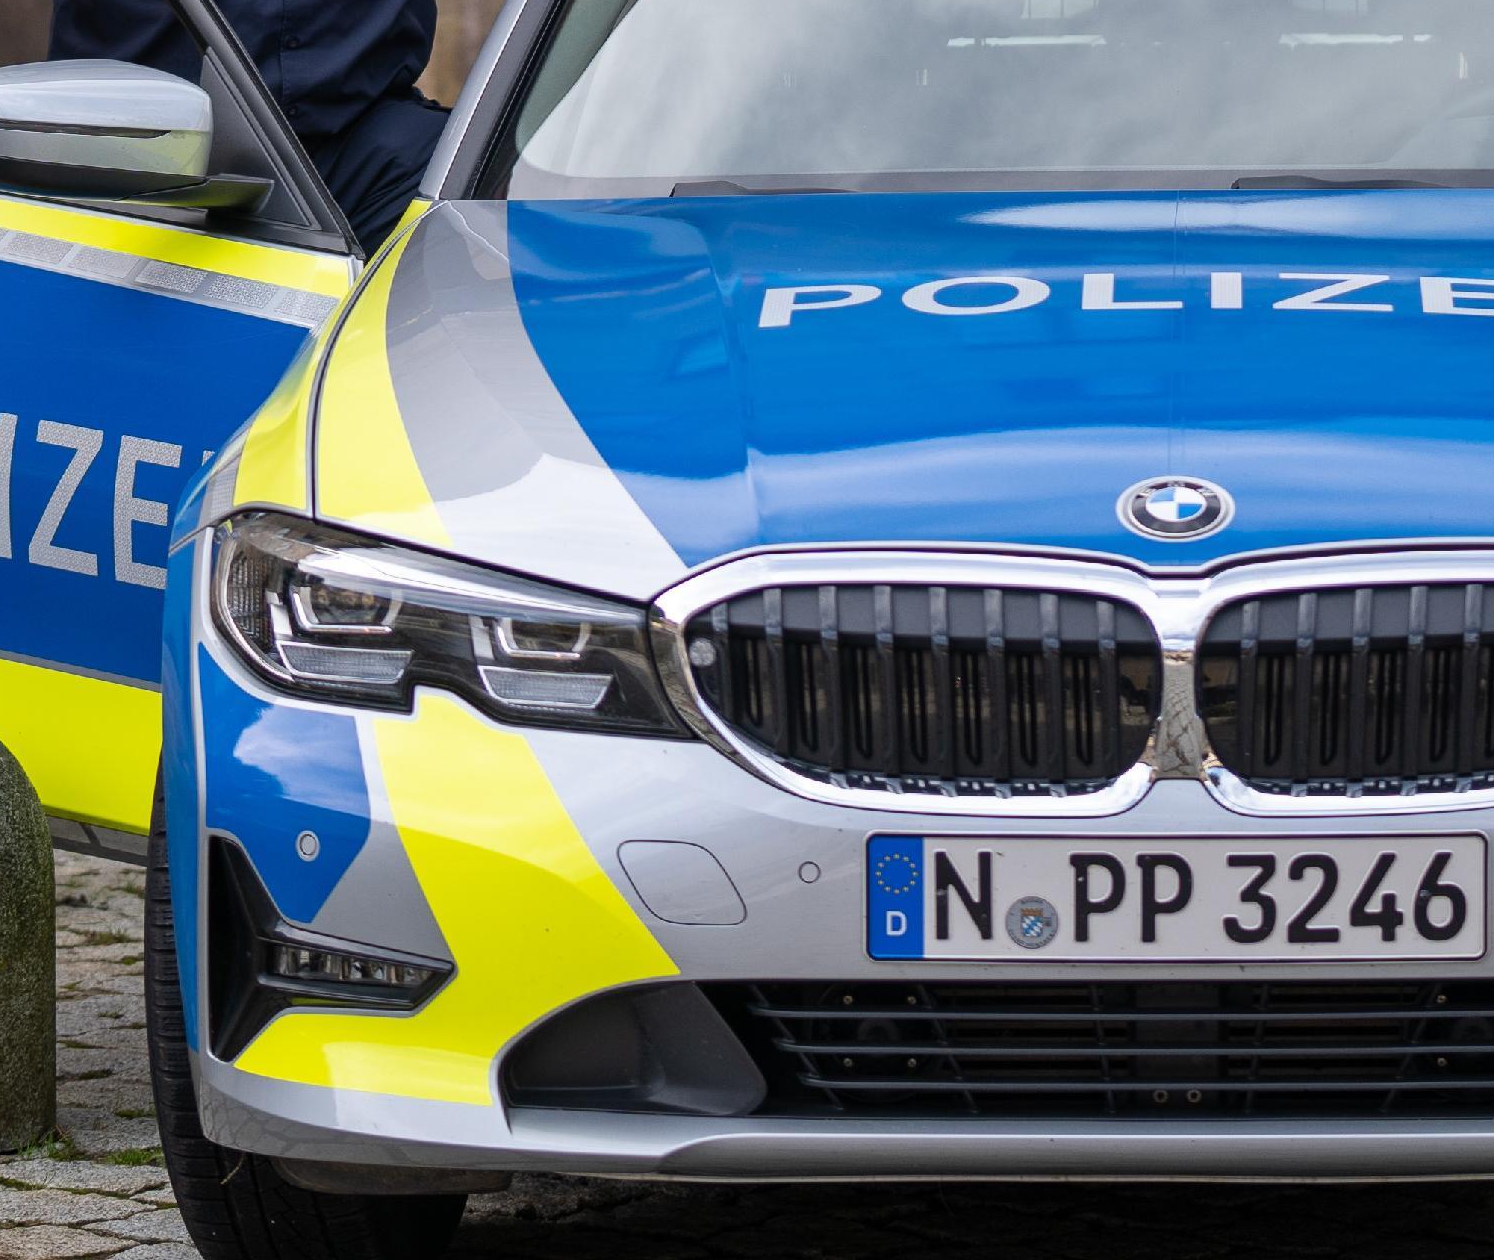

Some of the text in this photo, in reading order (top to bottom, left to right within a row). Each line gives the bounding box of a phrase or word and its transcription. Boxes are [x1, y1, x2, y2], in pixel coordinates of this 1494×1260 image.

[886, 910, 908, 936] D
[934, 850, 995, 941] N
[1068, 851, 1194, 943] PP
[1221, 850, 1468, 944] 3246
